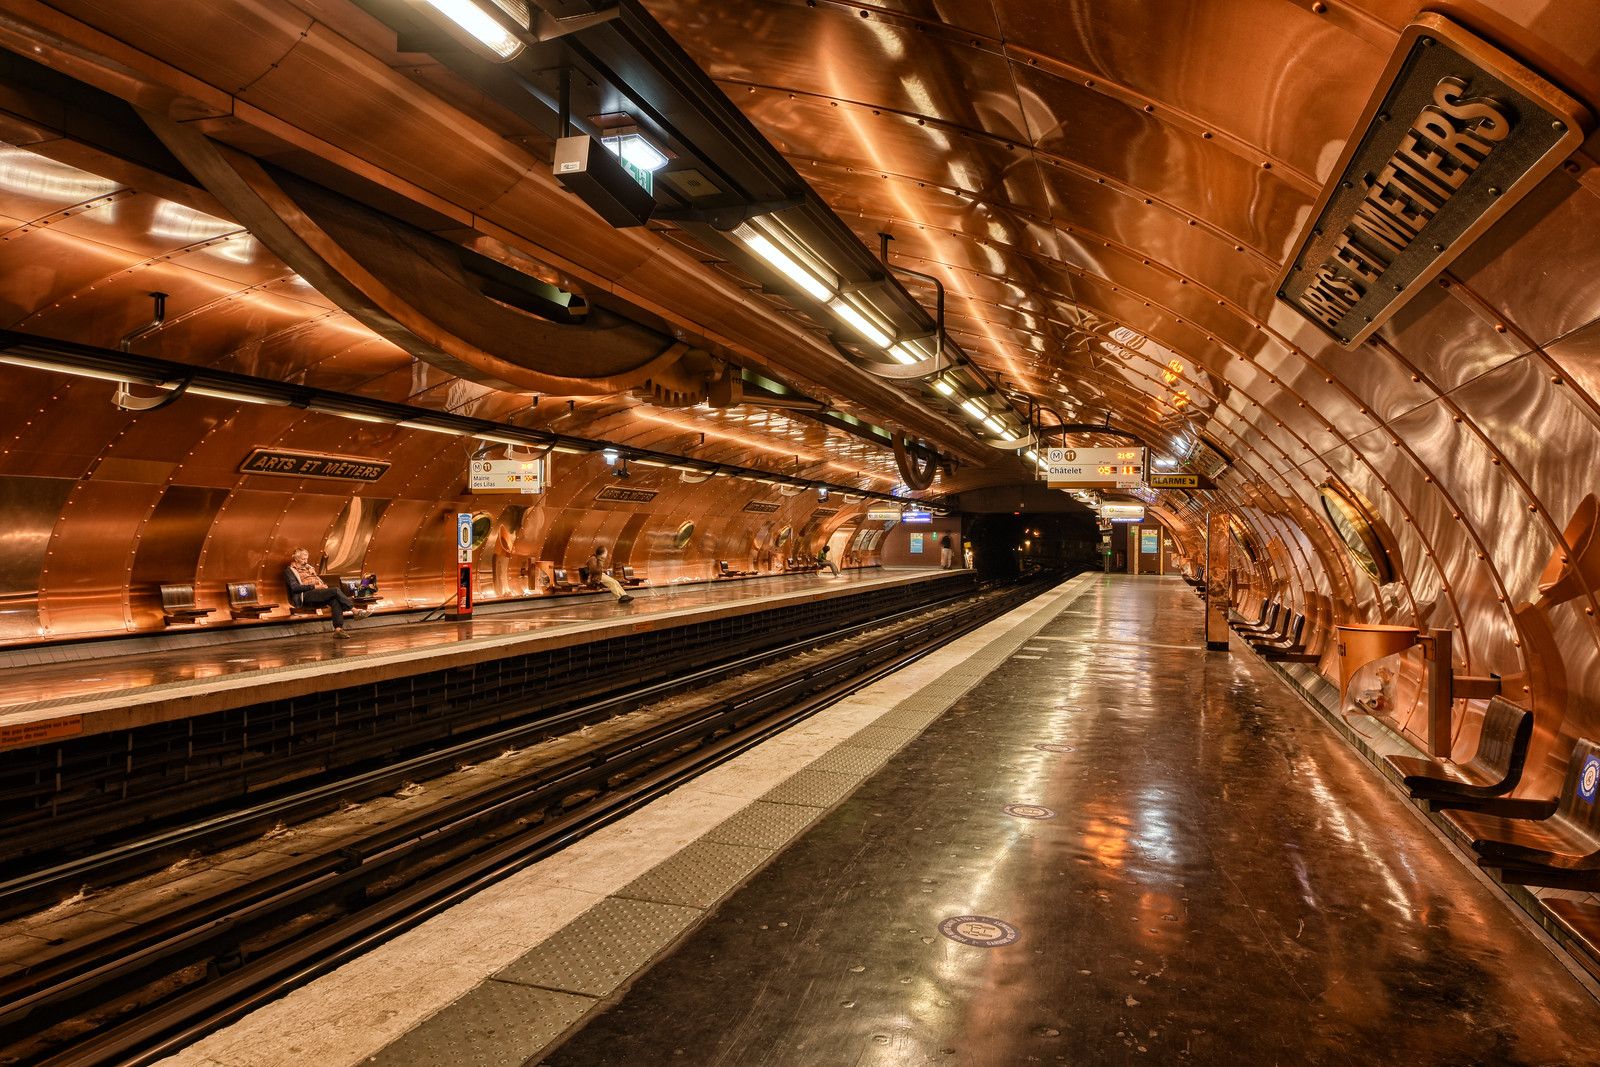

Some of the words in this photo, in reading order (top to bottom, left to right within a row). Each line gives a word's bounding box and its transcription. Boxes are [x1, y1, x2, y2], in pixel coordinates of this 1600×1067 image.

[1351, 76, 1511, 254] MÉTIERS
[1332, 228, 1388, 284] ET
[1300, 264, 1365, 328] ARTS
[253, 456, 297, 470] ARTS
[300, 460, 321, 472] ET
[1065, 452, 1075, 460] 11
[1049, 466, 1082, 474] Châtelet
[1122, 466, 1134, 475] 11
